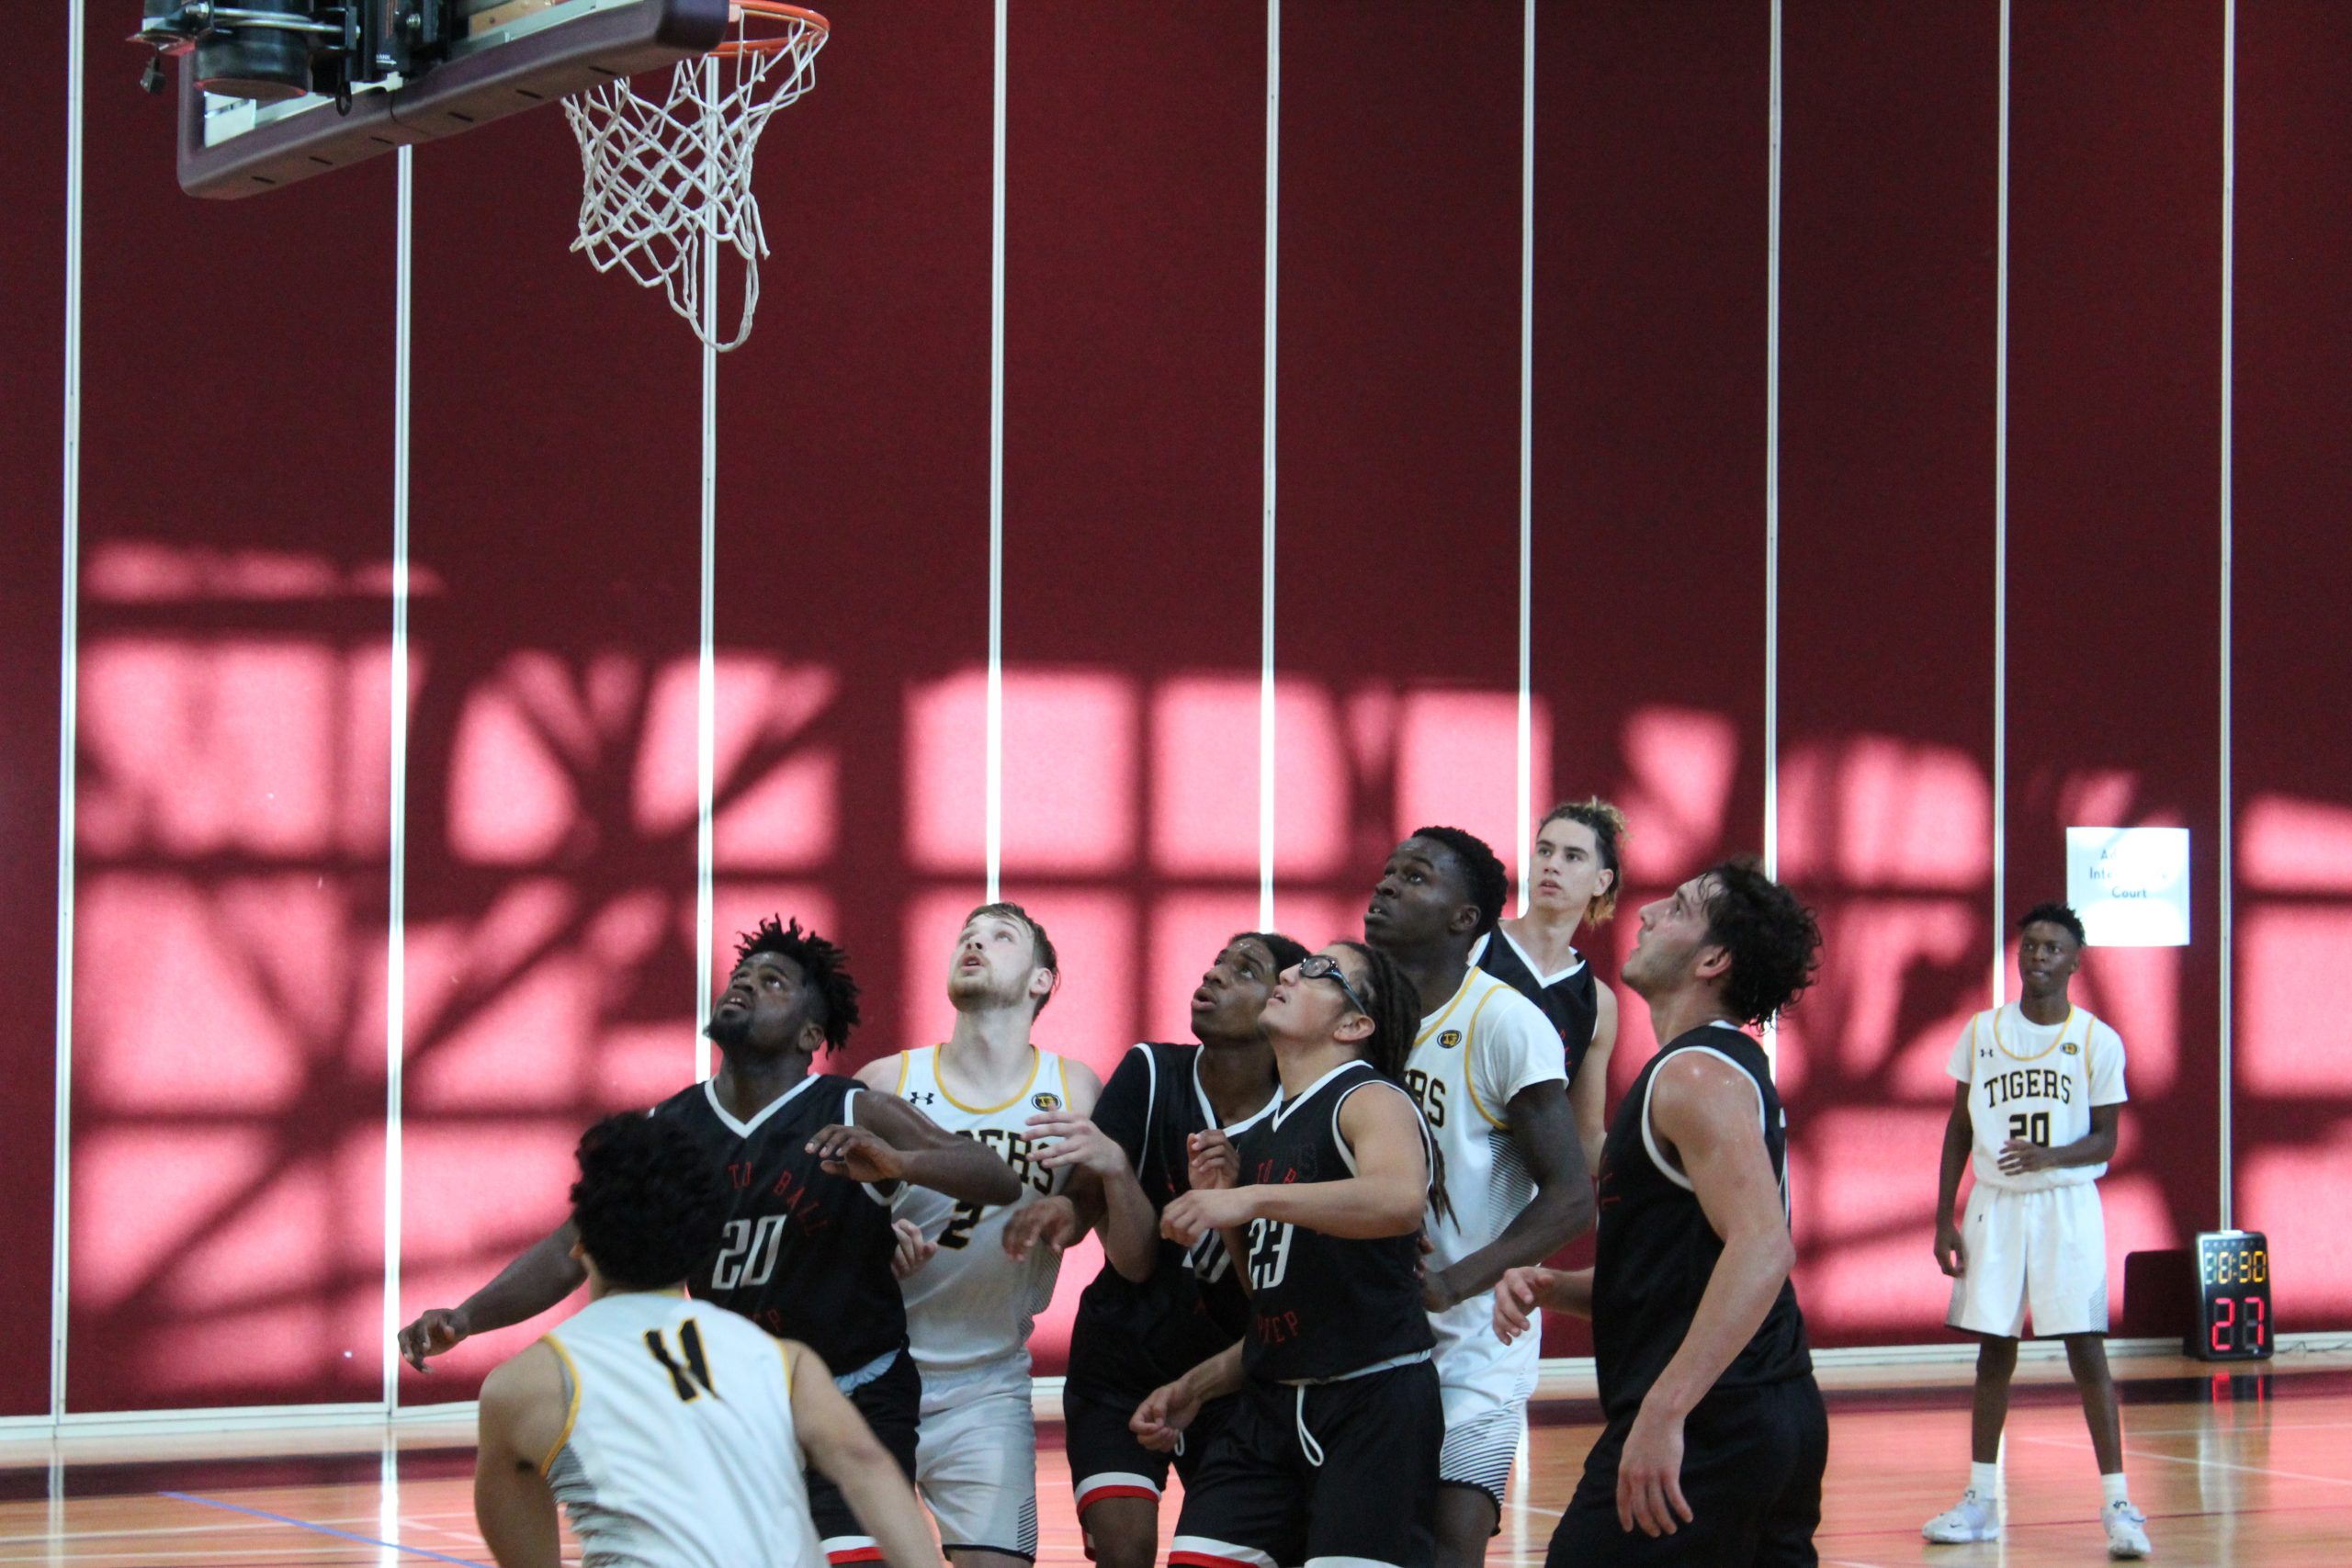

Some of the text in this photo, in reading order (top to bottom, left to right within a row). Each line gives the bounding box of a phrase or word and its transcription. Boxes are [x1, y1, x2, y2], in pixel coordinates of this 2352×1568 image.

[2111, 886, 2147, 898] Court
[1984, 1069, 2073, 1108] TIGERS
[2009, 1111, 2051, 1147] 20
[937, 1201, 985, 1249] 2
[711, 1214, 786, 1290] 20
[1248, 1217, 1294, 1291] 23
[2211, 1297, 2265, 1350] 27
[642, 1316, 718, 1404] 11
